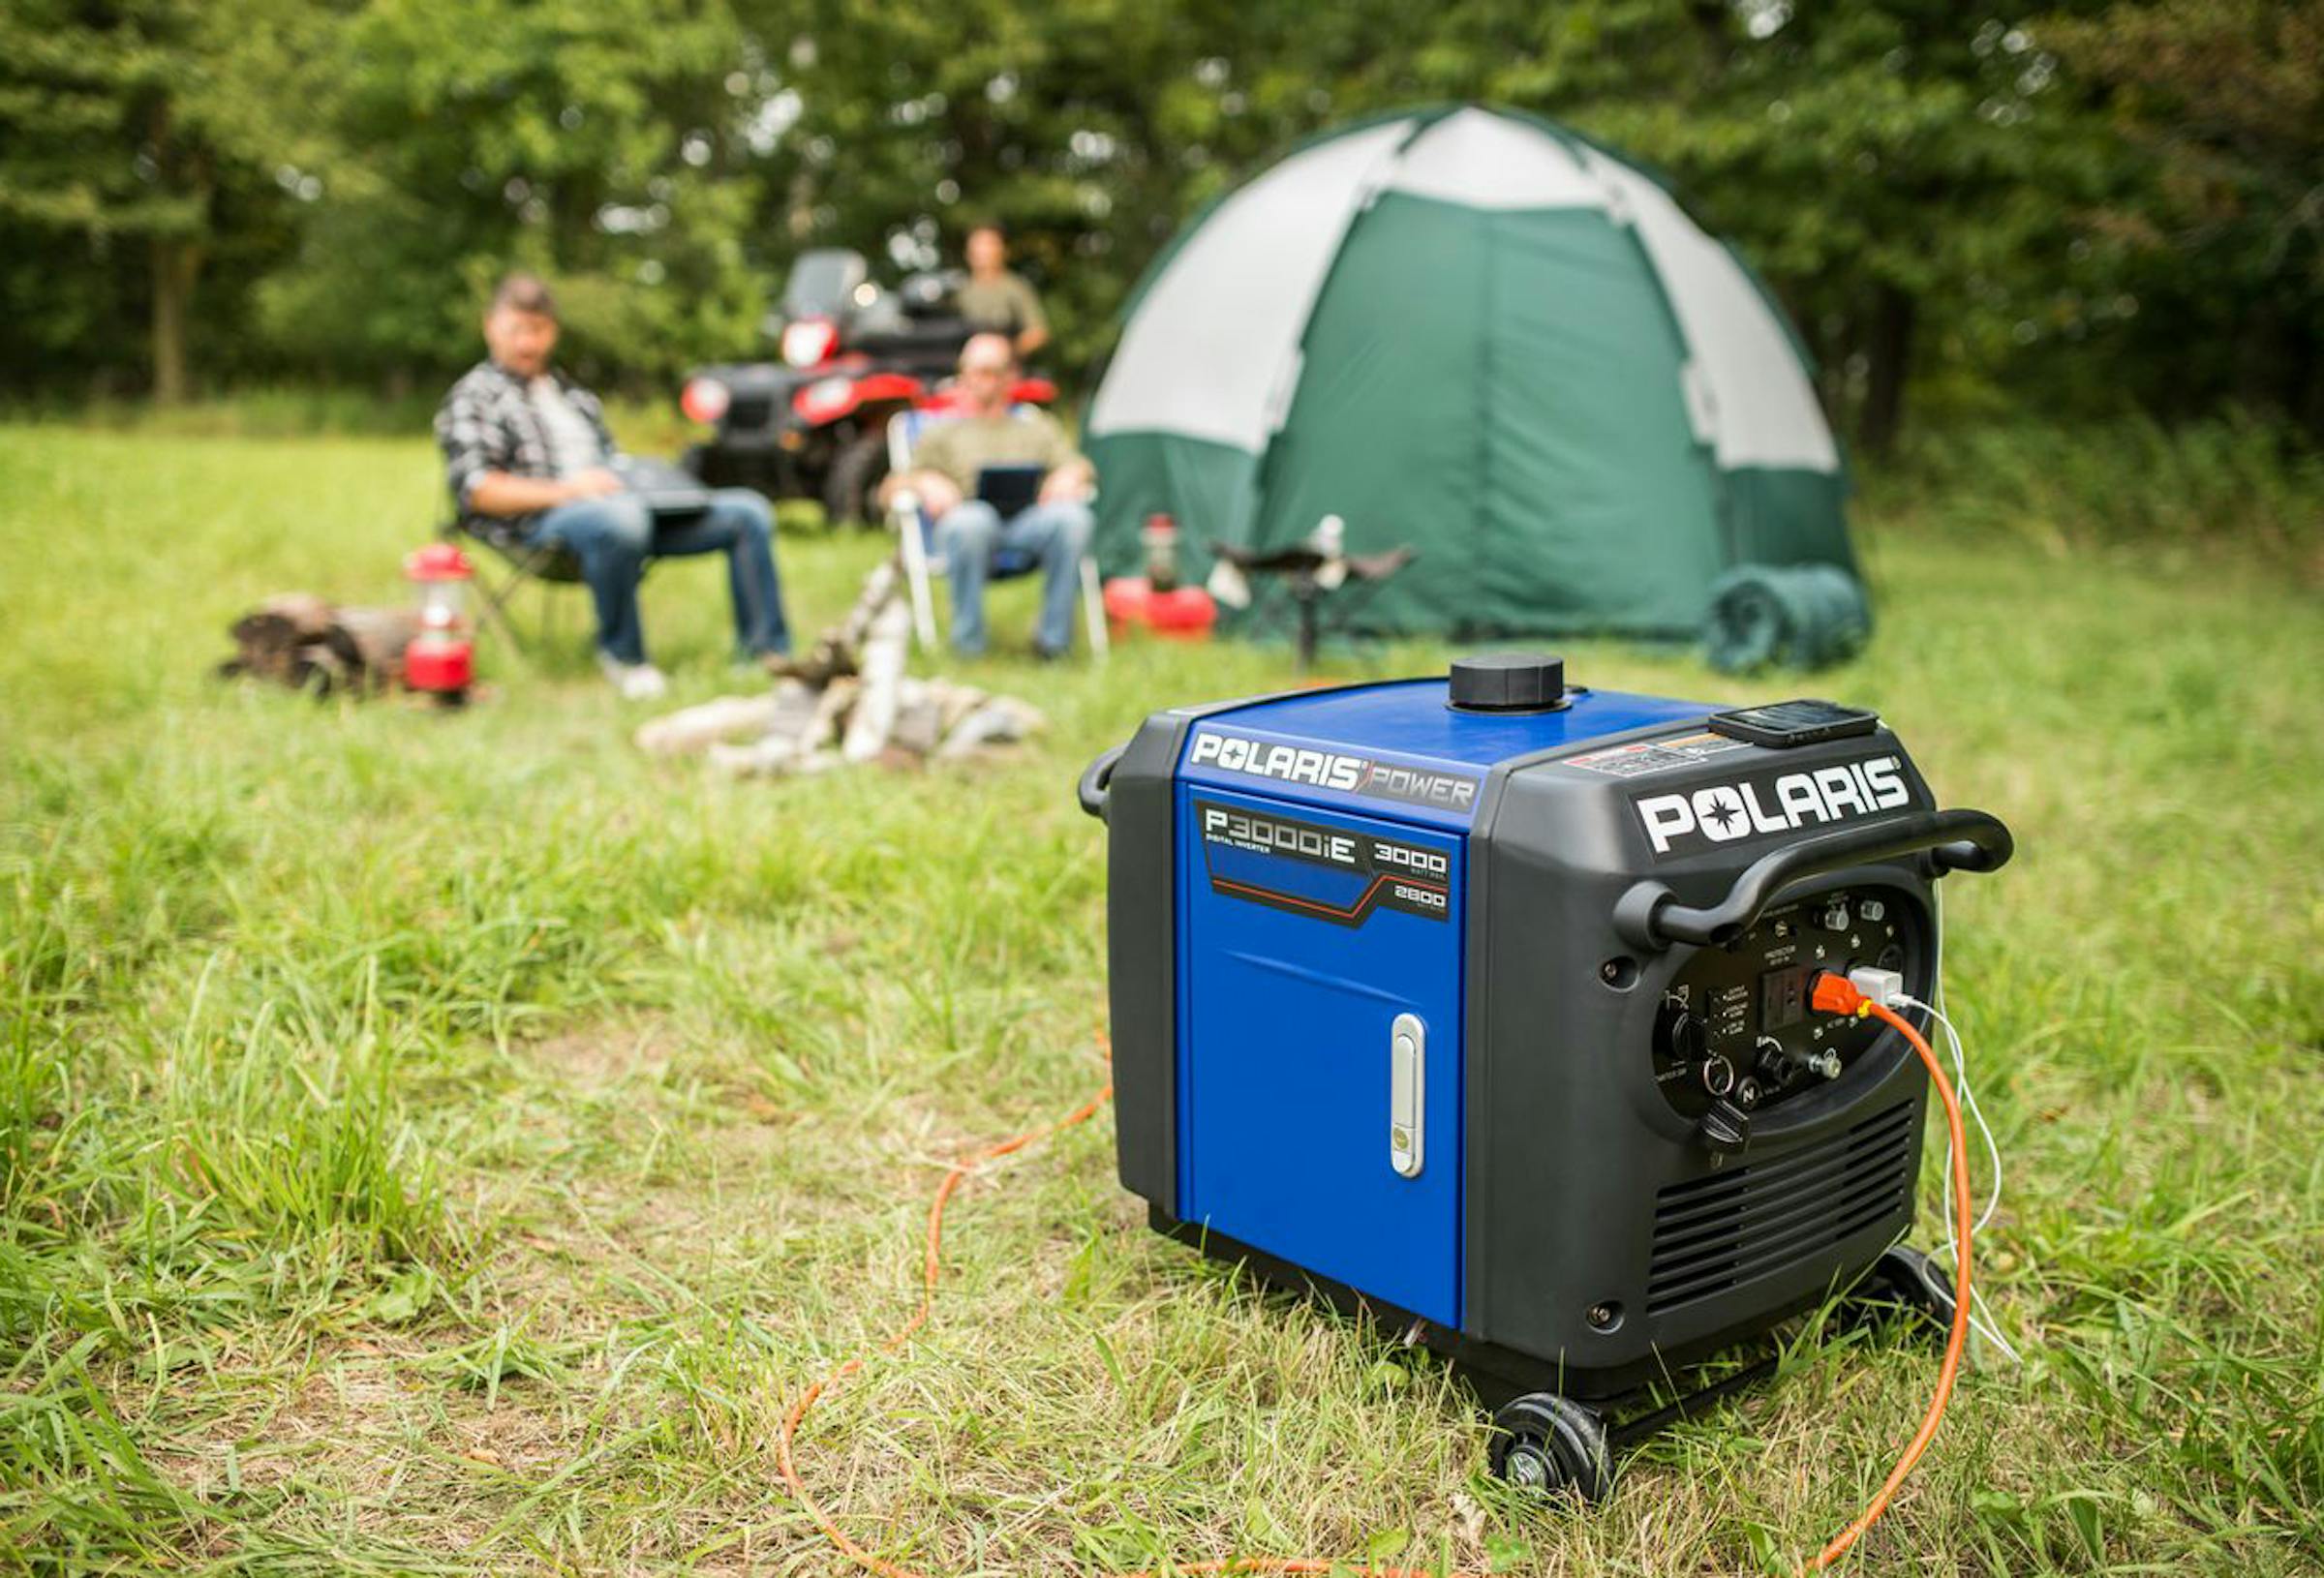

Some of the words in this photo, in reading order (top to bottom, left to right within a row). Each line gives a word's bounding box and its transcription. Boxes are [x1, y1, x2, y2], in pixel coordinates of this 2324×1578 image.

[1191, 732, 1361, 791] POLARIS
[1371, 767, 1475, 806] POWER
[1636, 756, 1910, 854] POLARIS
[1206, 808, 1356, 864] P3000iE
[1374, 842, 1448, 873] 3000
[1394, 885, 1447, 907] 2800
